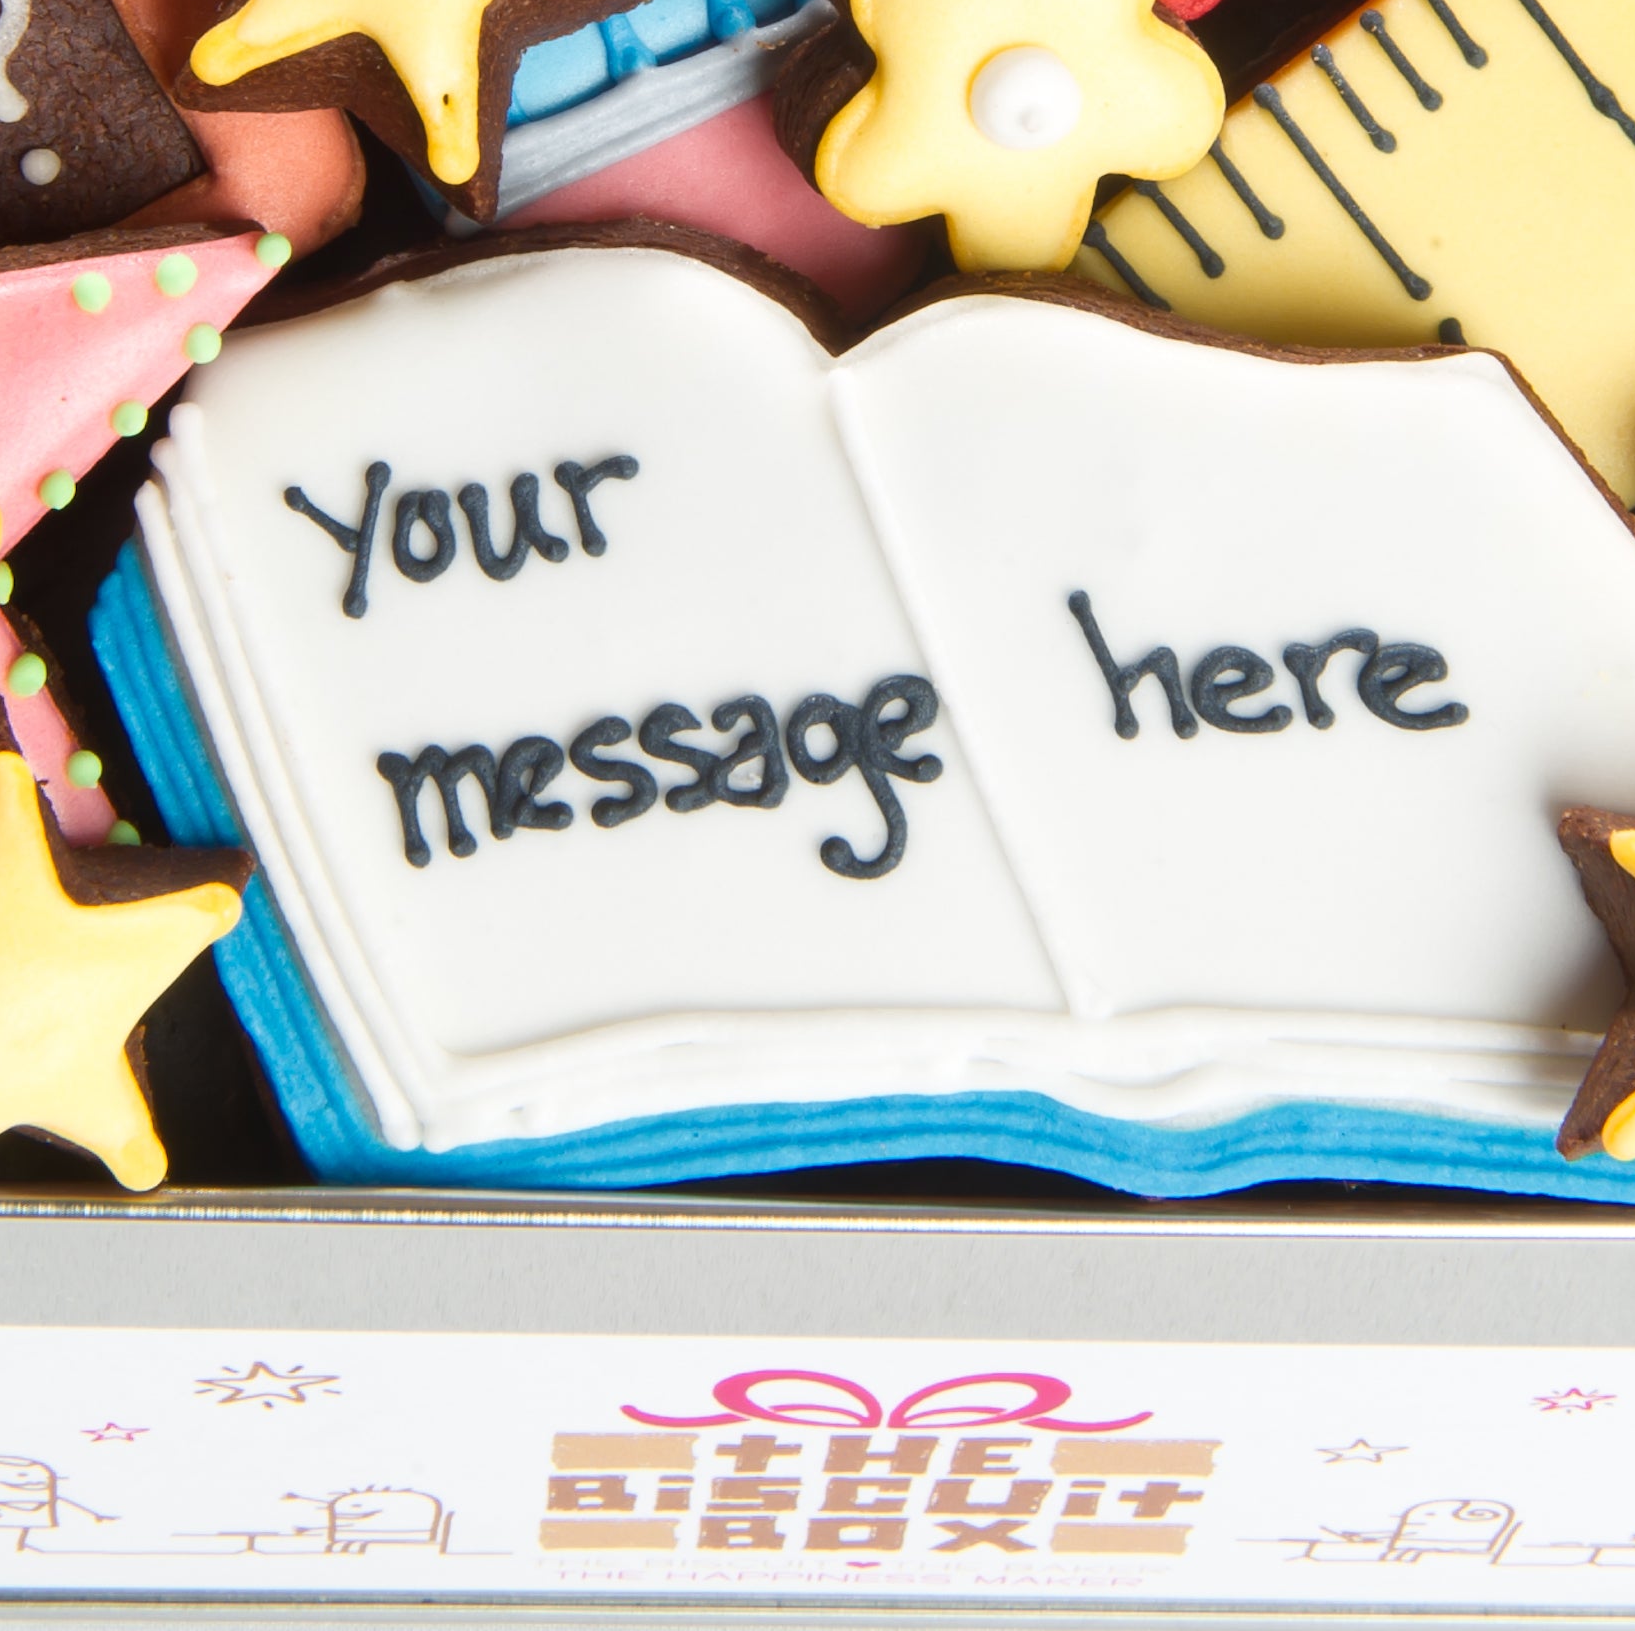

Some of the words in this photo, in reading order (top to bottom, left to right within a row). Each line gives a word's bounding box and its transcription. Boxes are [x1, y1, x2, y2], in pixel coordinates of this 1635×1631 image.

[1068, 590, 1469, 739] here
[377, 675, 942, 879] message
[557, 1570, 644, 1581] THE
[666, 1570, 951, 1584] HAPPINESS
[974, 1574, 1144, 1587] MAKER
[697, 1516, 1038, 1552] BOX
